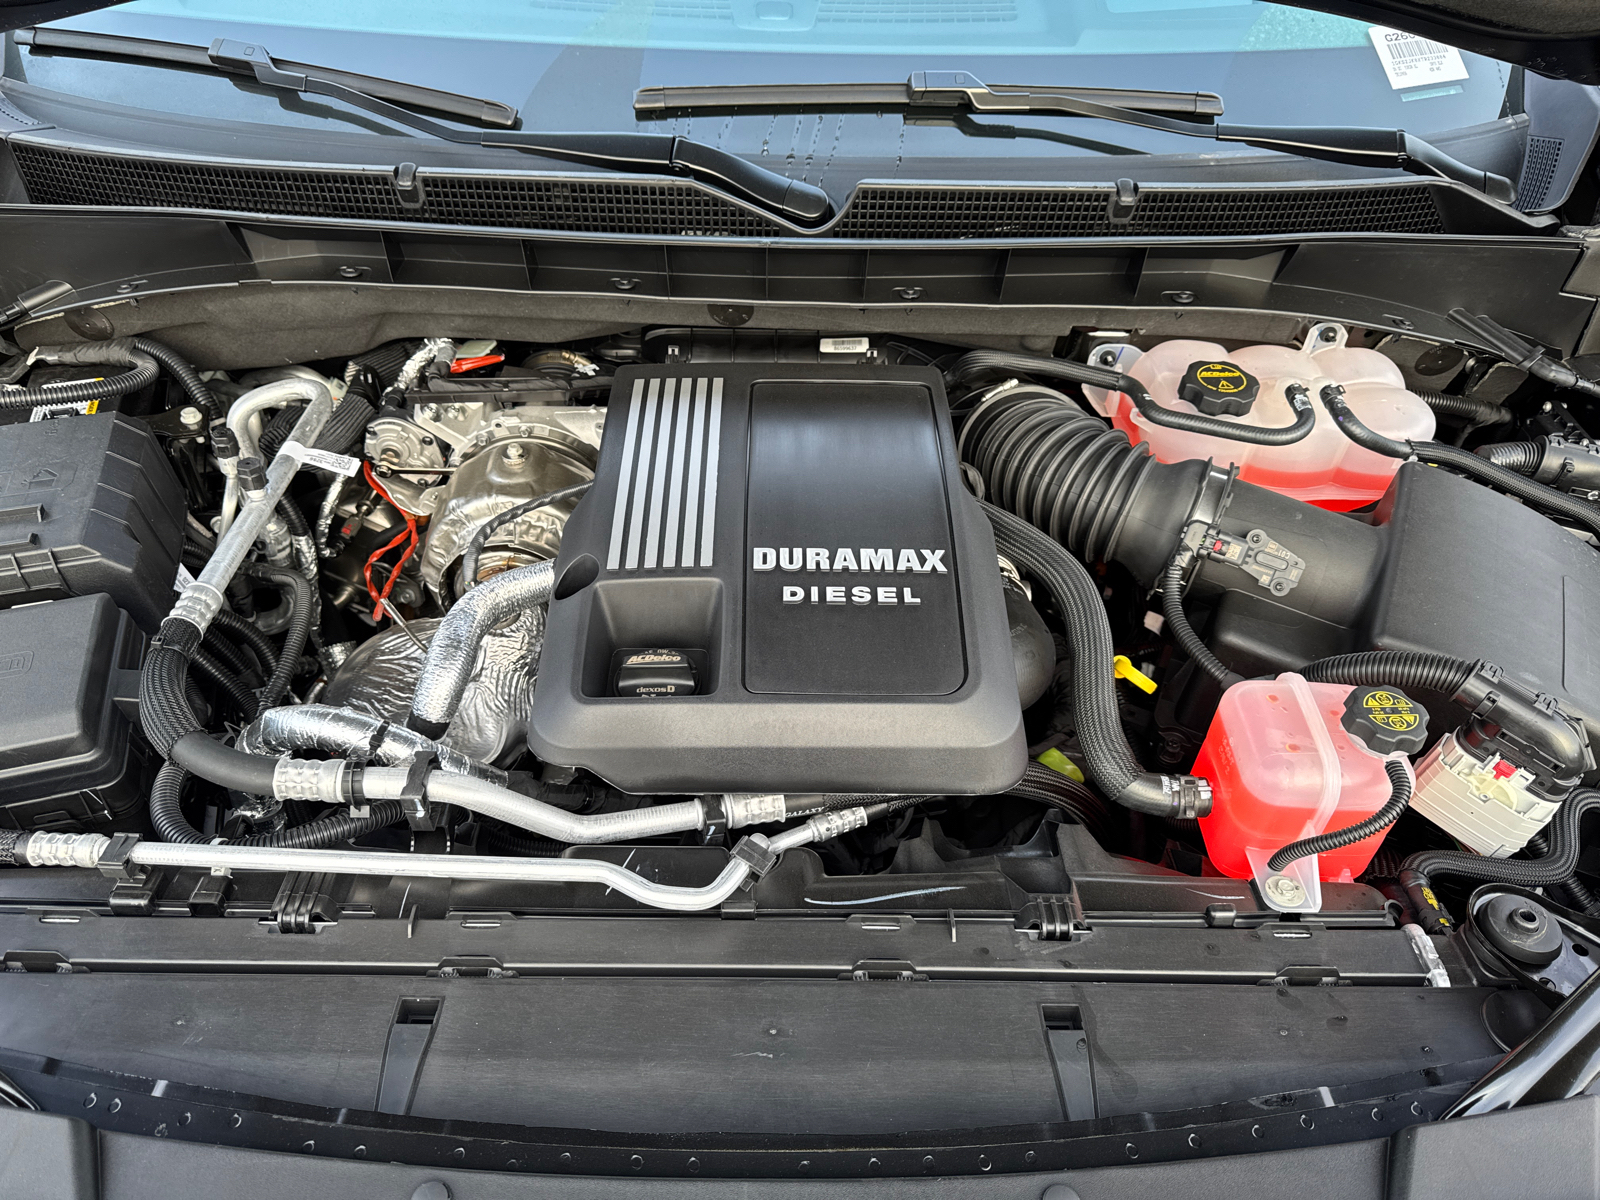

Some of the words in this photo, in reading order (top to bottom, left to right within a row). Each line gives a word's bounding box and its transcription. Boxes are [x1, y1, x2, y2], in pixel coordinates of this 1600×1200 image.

[752, 547, 948, 574] DURAMAX
[782, 585, 921, 605] DIESEL
[625, 654, 681, 665] ACDelco
[785, 806, 825, 818] GALAXY
